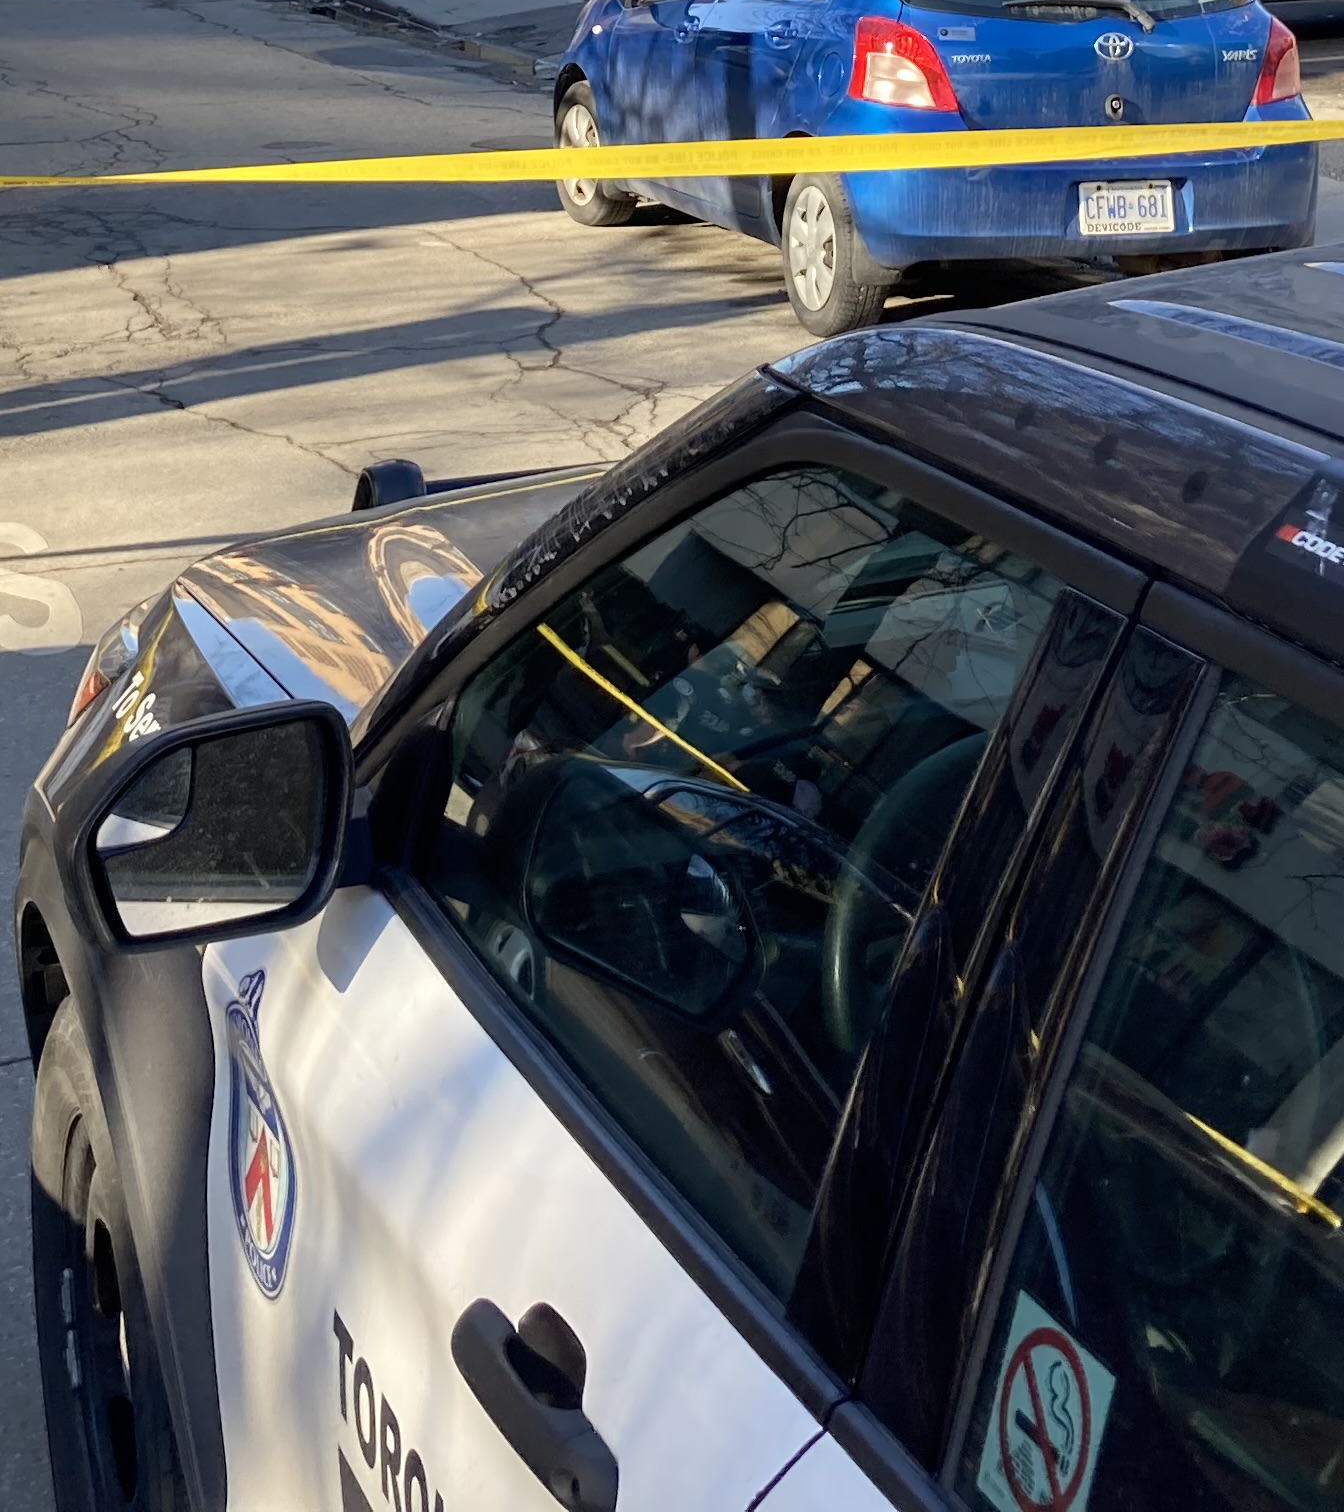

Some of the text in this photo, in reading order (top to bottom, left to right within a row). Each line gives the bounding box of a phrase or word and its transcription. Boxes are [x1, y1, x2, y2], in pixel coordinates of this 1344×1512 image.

[1221, 49, 1258, 62] YARIS
[1086, 194, 1167, 219] CFWB 681
[1087, 222, 1142, 232] DEVICODE
[112, 671, 144, 719] To
[333, 1308, 444, 1512] TORO
